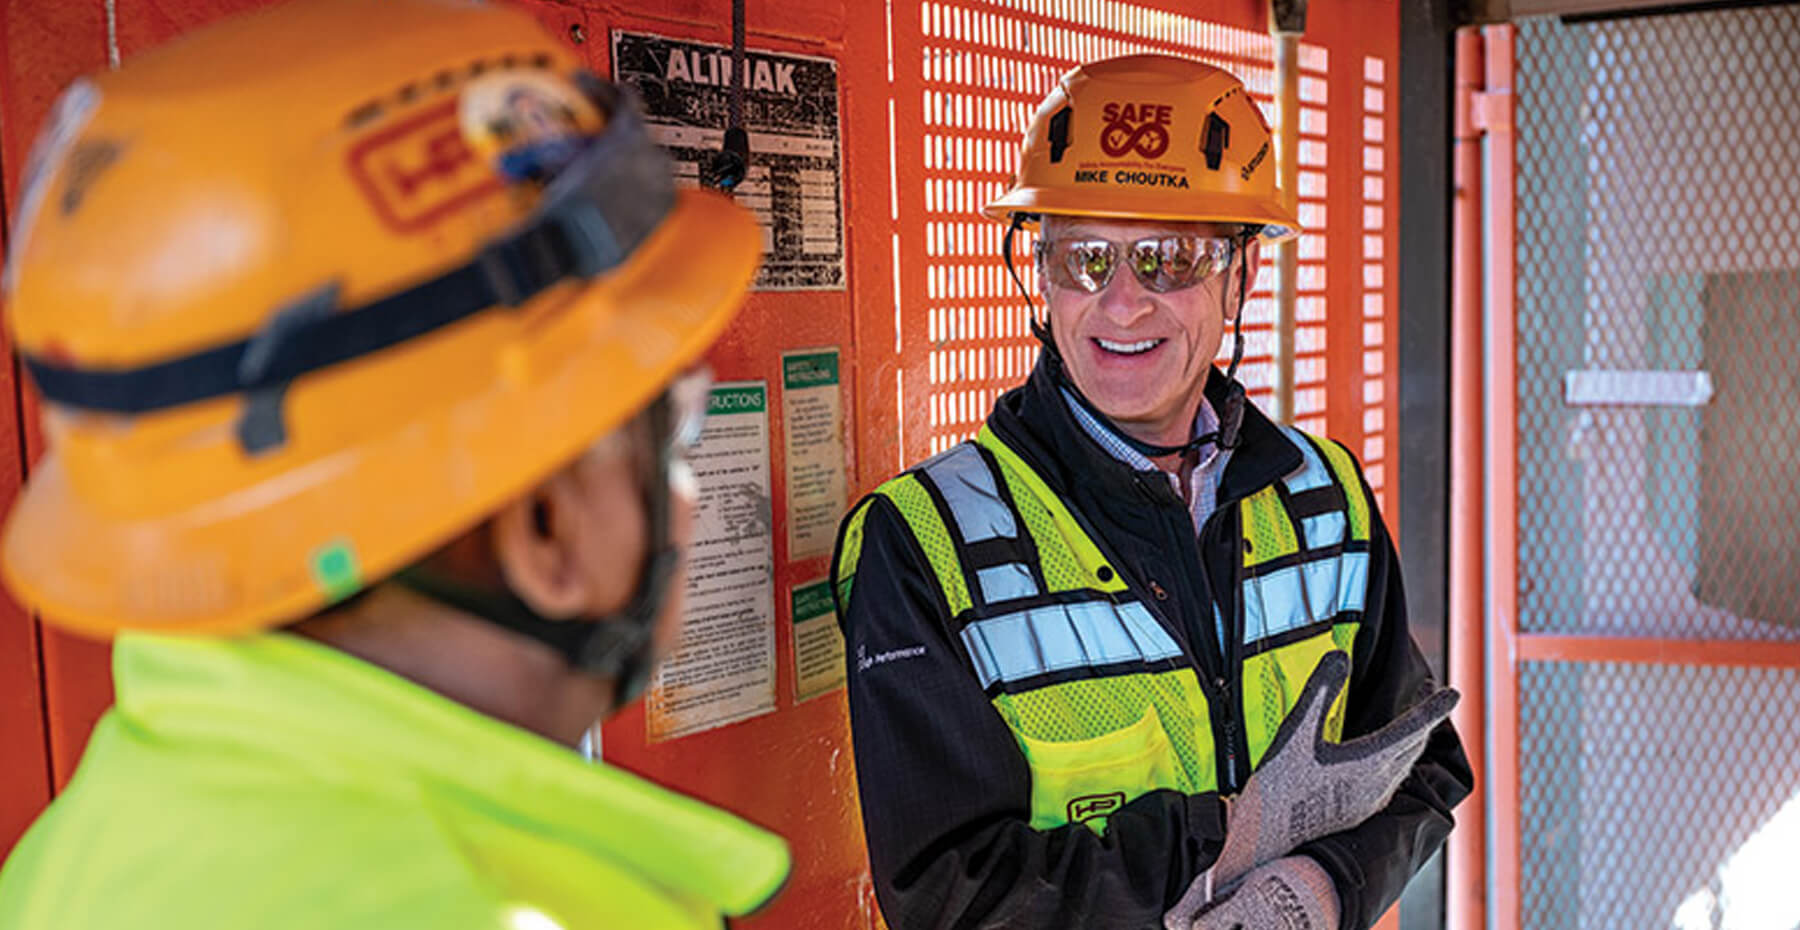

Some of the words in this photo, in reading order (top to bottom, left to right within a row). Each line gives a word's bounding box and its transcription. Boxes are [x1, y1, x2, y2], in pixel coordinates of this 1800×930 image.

[1102, 102, 1173, 125] SAFE
[1074, 170, 1109, 183] MIKE
[1114, 170, 1190, 189] CHOUTKA
